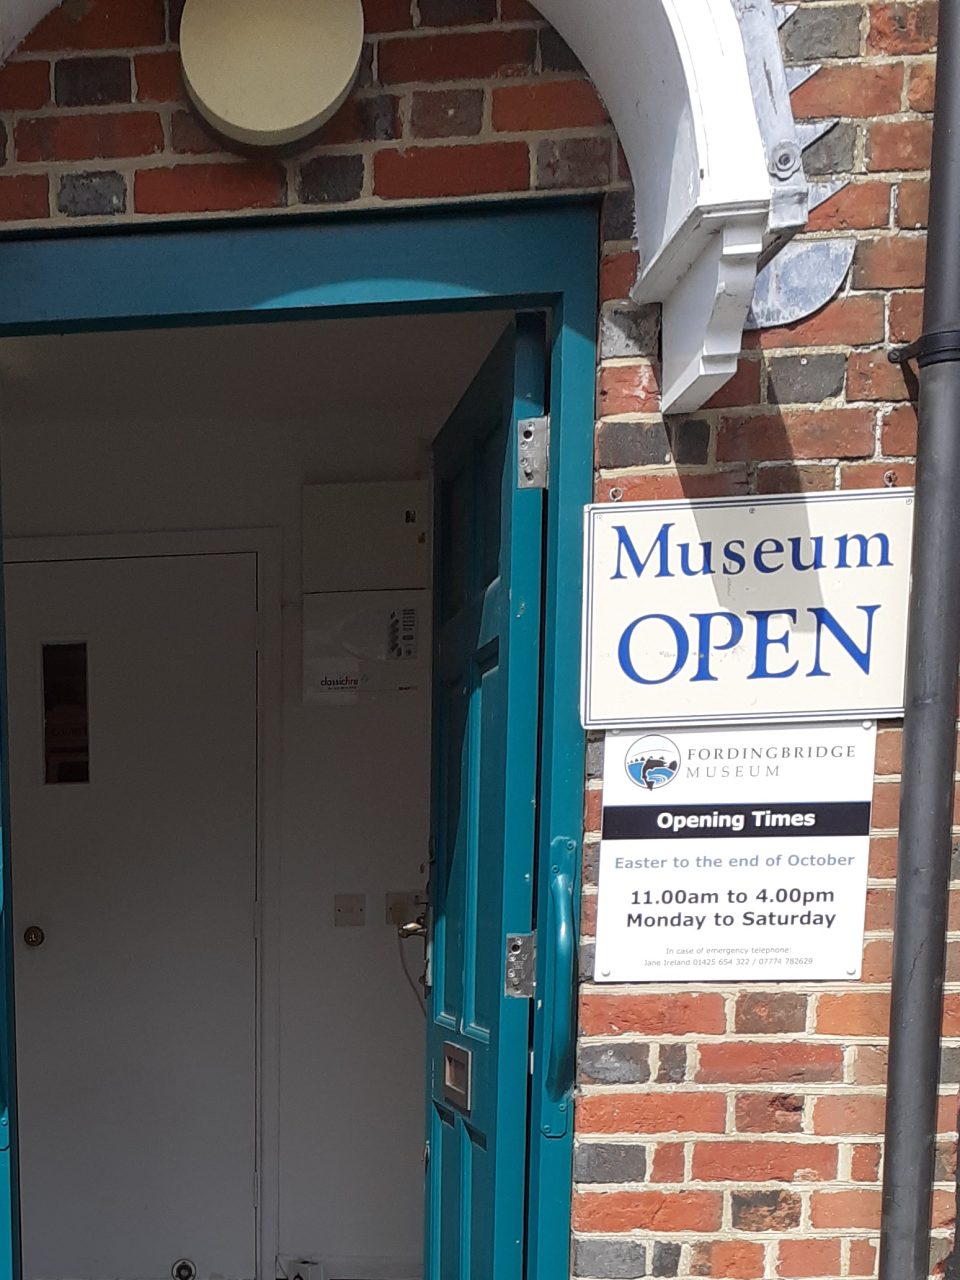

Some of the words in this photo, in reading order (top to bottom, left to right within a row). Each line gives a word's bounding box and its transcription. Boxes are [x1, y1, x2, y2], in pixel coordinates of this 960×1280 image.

[609, 521, 894, 580] Museum
[617, 604, 881, 685] OPEN
[687, 745, 856, 760] FORDINGBRIDGE
[686, 765, 780, 778] MUSEUM
[657, 811, 745, 832] Opening
[752, 810, 816, 827] Times
[614, 857, 667, 869] Easter
[673, 857, 689, 868] to
[695, 855, 722, 868] the
[728, 855, 759, 867] end
[765, 854, 782, 867] of
[787, 854, 855, 867] October
[631, 889, 719, 905] 11.00am
[727, 889, 747, 904] to
[755, 888, 835, 906] 4.00pm
[626, 912, 706, 930] Monday
[714, 912, 734, 926] to
[742, 910, 836, 928] Saturday
[666, 947, 674, 955] In
[696, 946, 704, 955] of
[706, 948, 749, 956] emergency
[663, 958, 691, 967] Ireland
[692, 958, 716, 966] 01425
[718, 958, 733, 966] 654
[736, 957, 750, 966] 322
[758, 957, 782, 966] 07774
[785, 956, 814, 965] 782629
